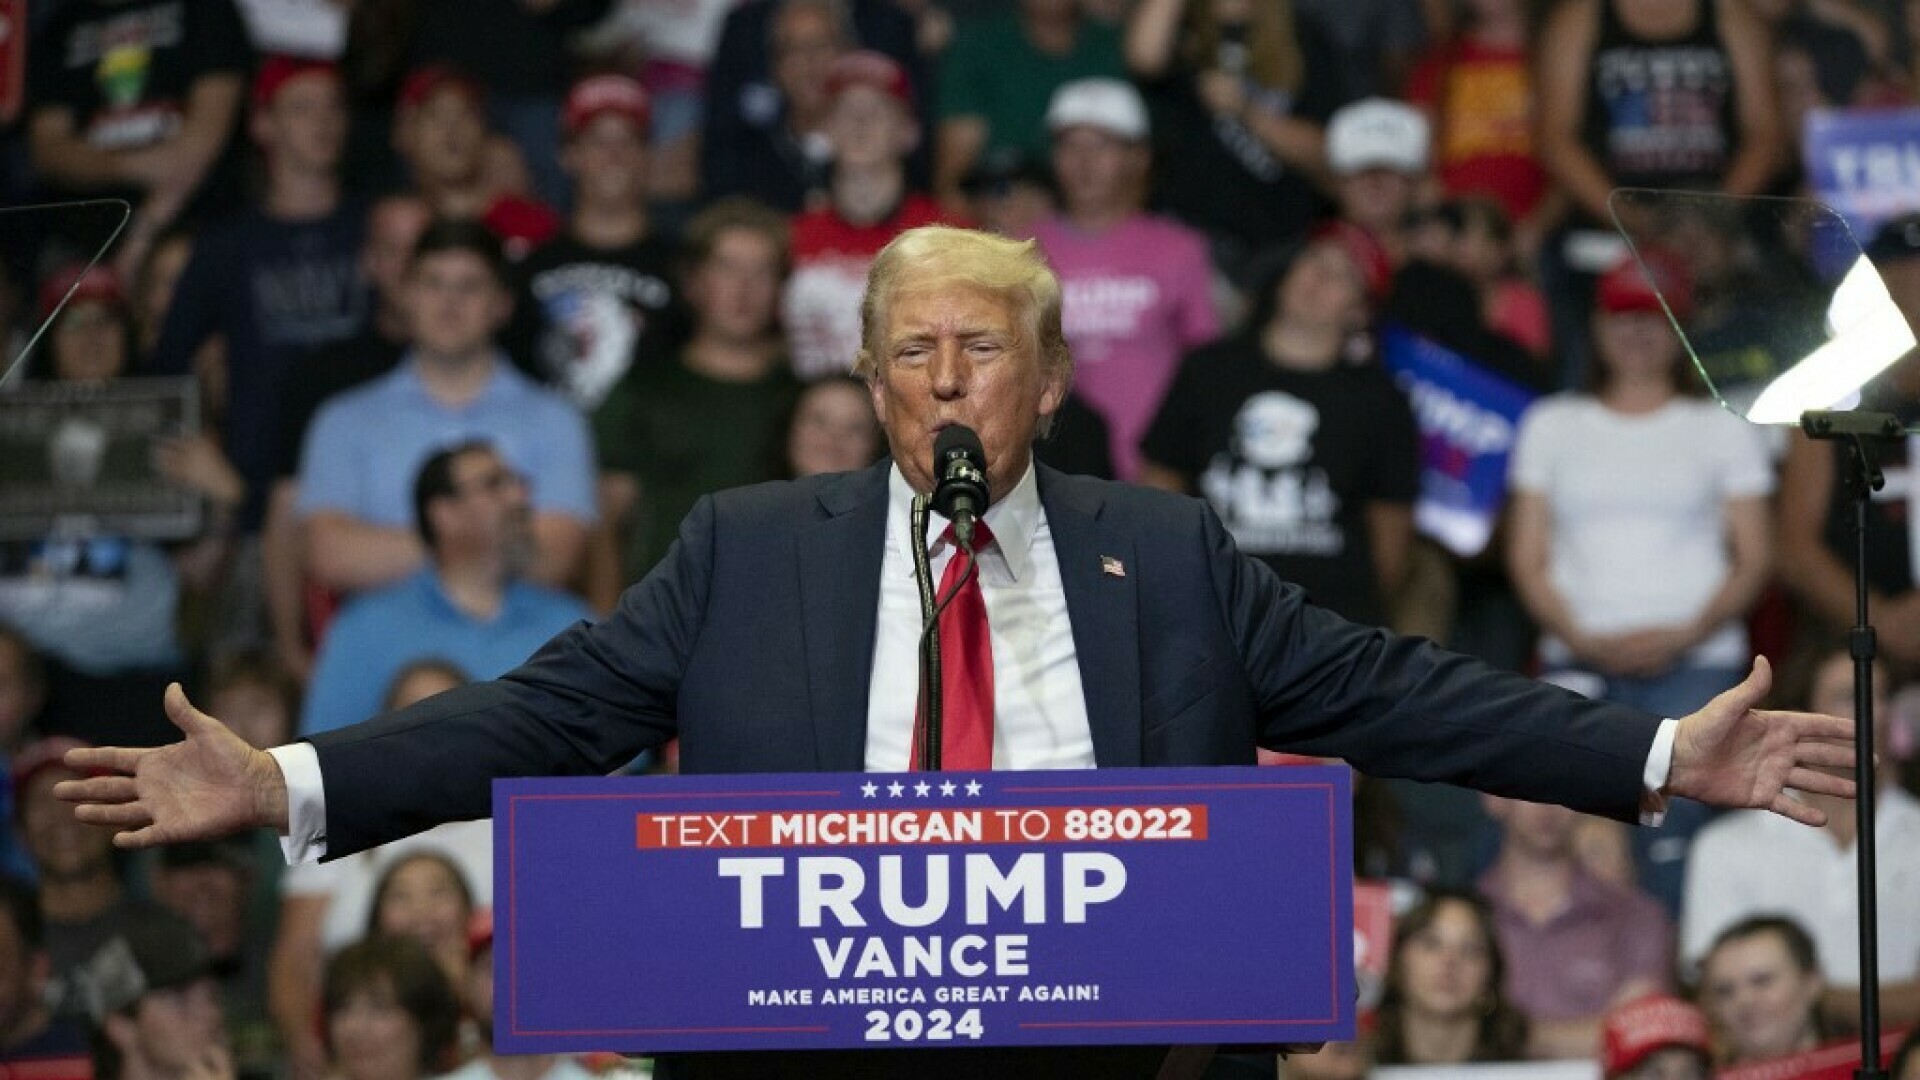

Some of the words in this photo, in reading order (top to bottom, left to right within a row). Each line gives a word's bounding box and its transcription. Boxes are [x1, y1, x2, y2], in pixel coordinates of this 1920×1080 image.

[652, 815, 758, 847] TEXT
[771, 810, 983, 845] MICHIGAN
[994, 809, 1051, 841] TO
[1064, 807, 1193, 841] 88022
[718, 852, 1128, 929] TRUMP
[813, 933, 1030, 980] VANCE
[747, 988, 813, 1006] MAKE
[820, 987, 927, 1006] AMERICA
[934, 985, 1010, 1004] GREAT
[1017, 984, 1100, 1003] AGAIN!
[864, 1009, 985, 1042] 2024
